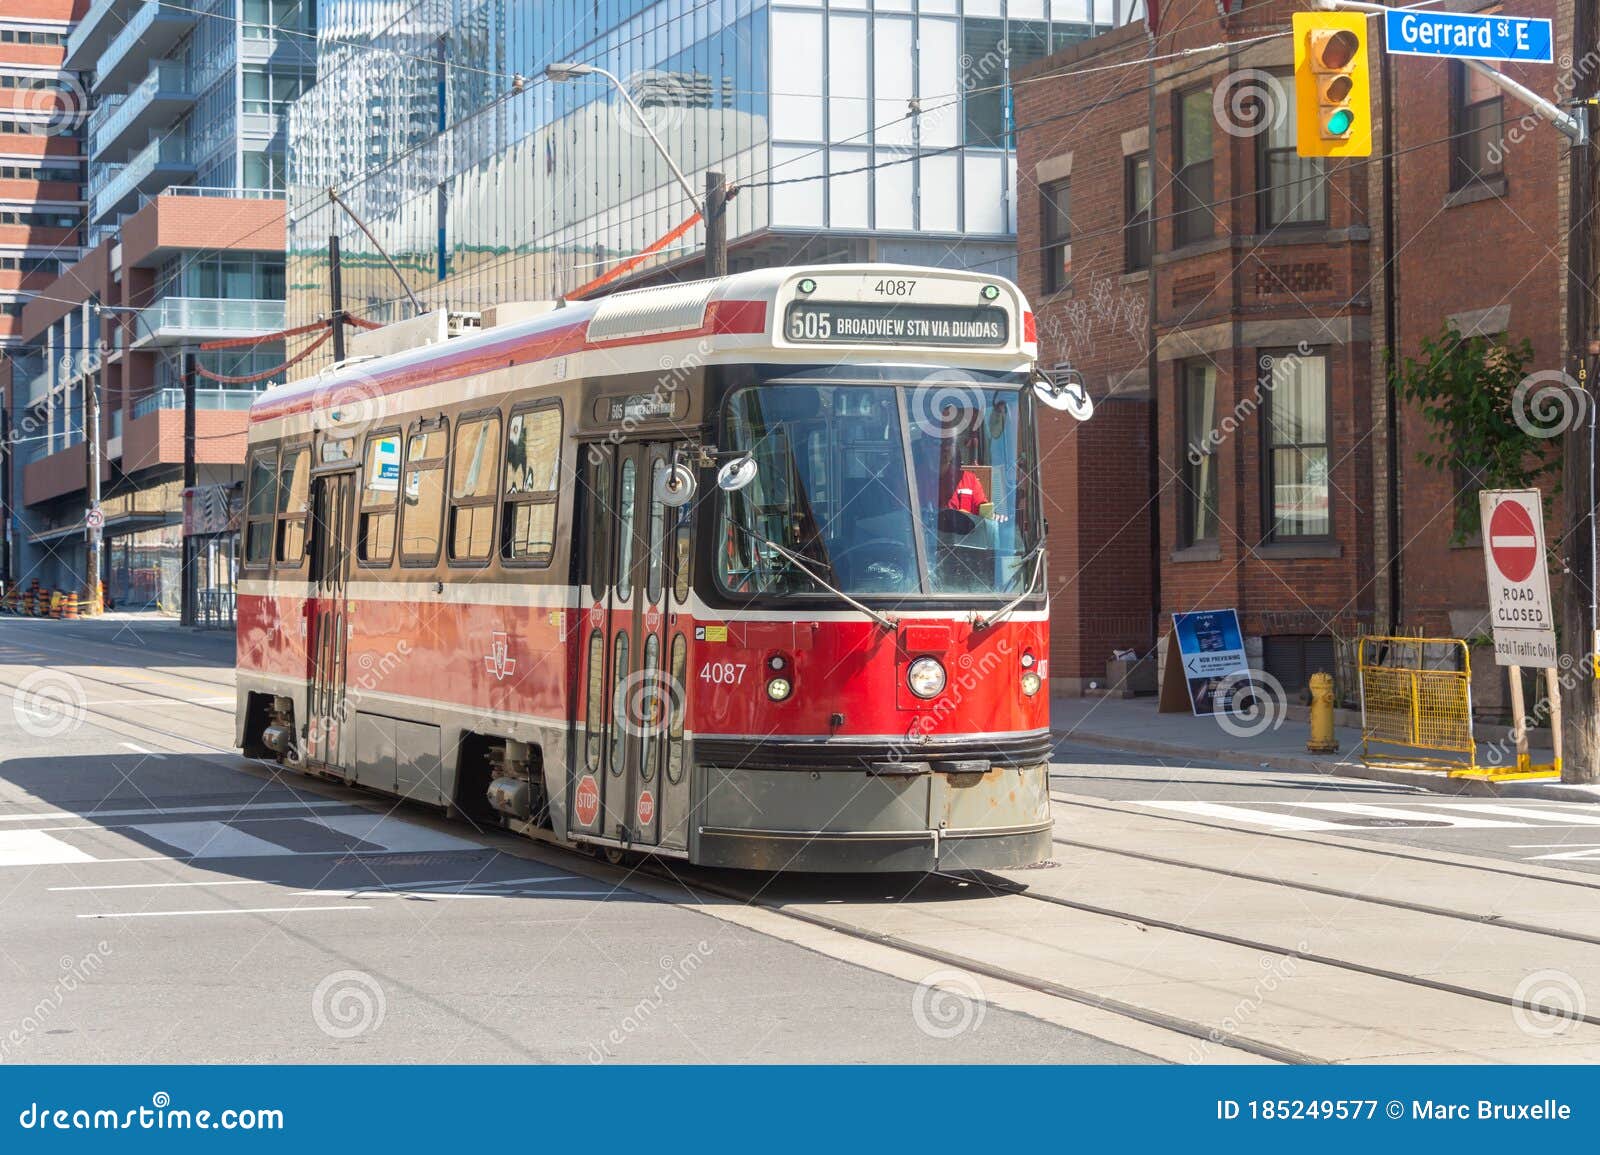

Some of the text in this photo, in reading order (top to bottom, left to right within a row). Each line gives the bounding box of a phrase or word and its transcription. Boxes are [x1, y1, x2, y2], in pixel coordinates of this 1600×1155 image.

[1401, 14, 1530, 51] Gerrard St E
[874, 279, 917, 296] 4087
[791, 312, 998, 339] 505 BROADVIEW STN VIA DUNDAS
[1503, 588, 1534, 601] ROAD
[1498, 607, 1543, 622] CLOSED
[1513, 640, 1536, 657] Traffic
[1537, 643, 1555, 661] Only
[700, 662, 747, 684] 4087
[578, 792, 597, 808] STOP
